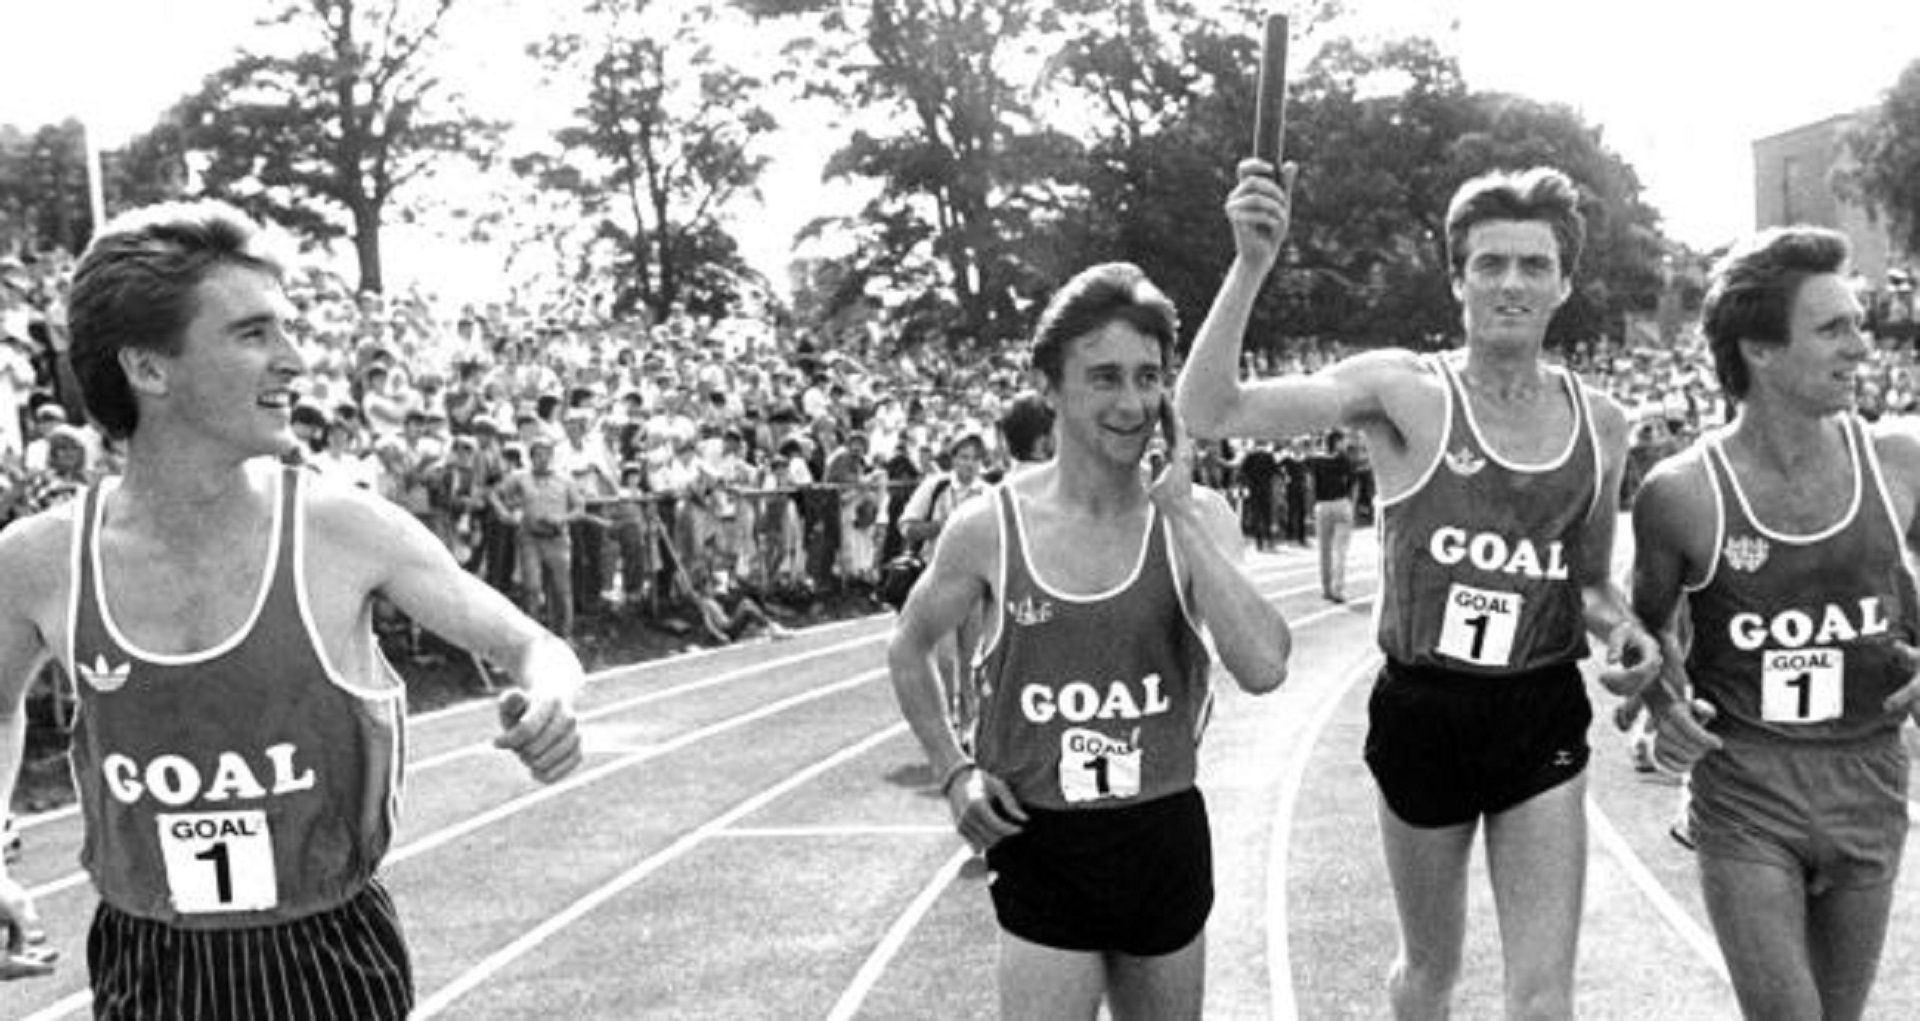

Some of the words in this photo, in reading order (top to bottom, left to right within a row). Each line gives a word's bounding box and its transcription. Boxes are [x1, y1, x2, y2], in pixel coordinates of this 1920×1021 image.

[1429, 526, 1569, 580] GOAL
[1454, 591, 1511, 613] GOAL
[1729, 596, 1889, 650] GOAL
[1464, 615, 1490, 659] 1
[1772, 653, 1832, 670] GOAL
[1020, 672, 1171, 723] GOAL
[1785, 672, 1811, 719] 1
[103, 743, 316, 804] GOAL
[1083, 755, 1111, 794] 1
[171, 818, 257, 839] GOAL
[194, 842, 233, 904] 1
